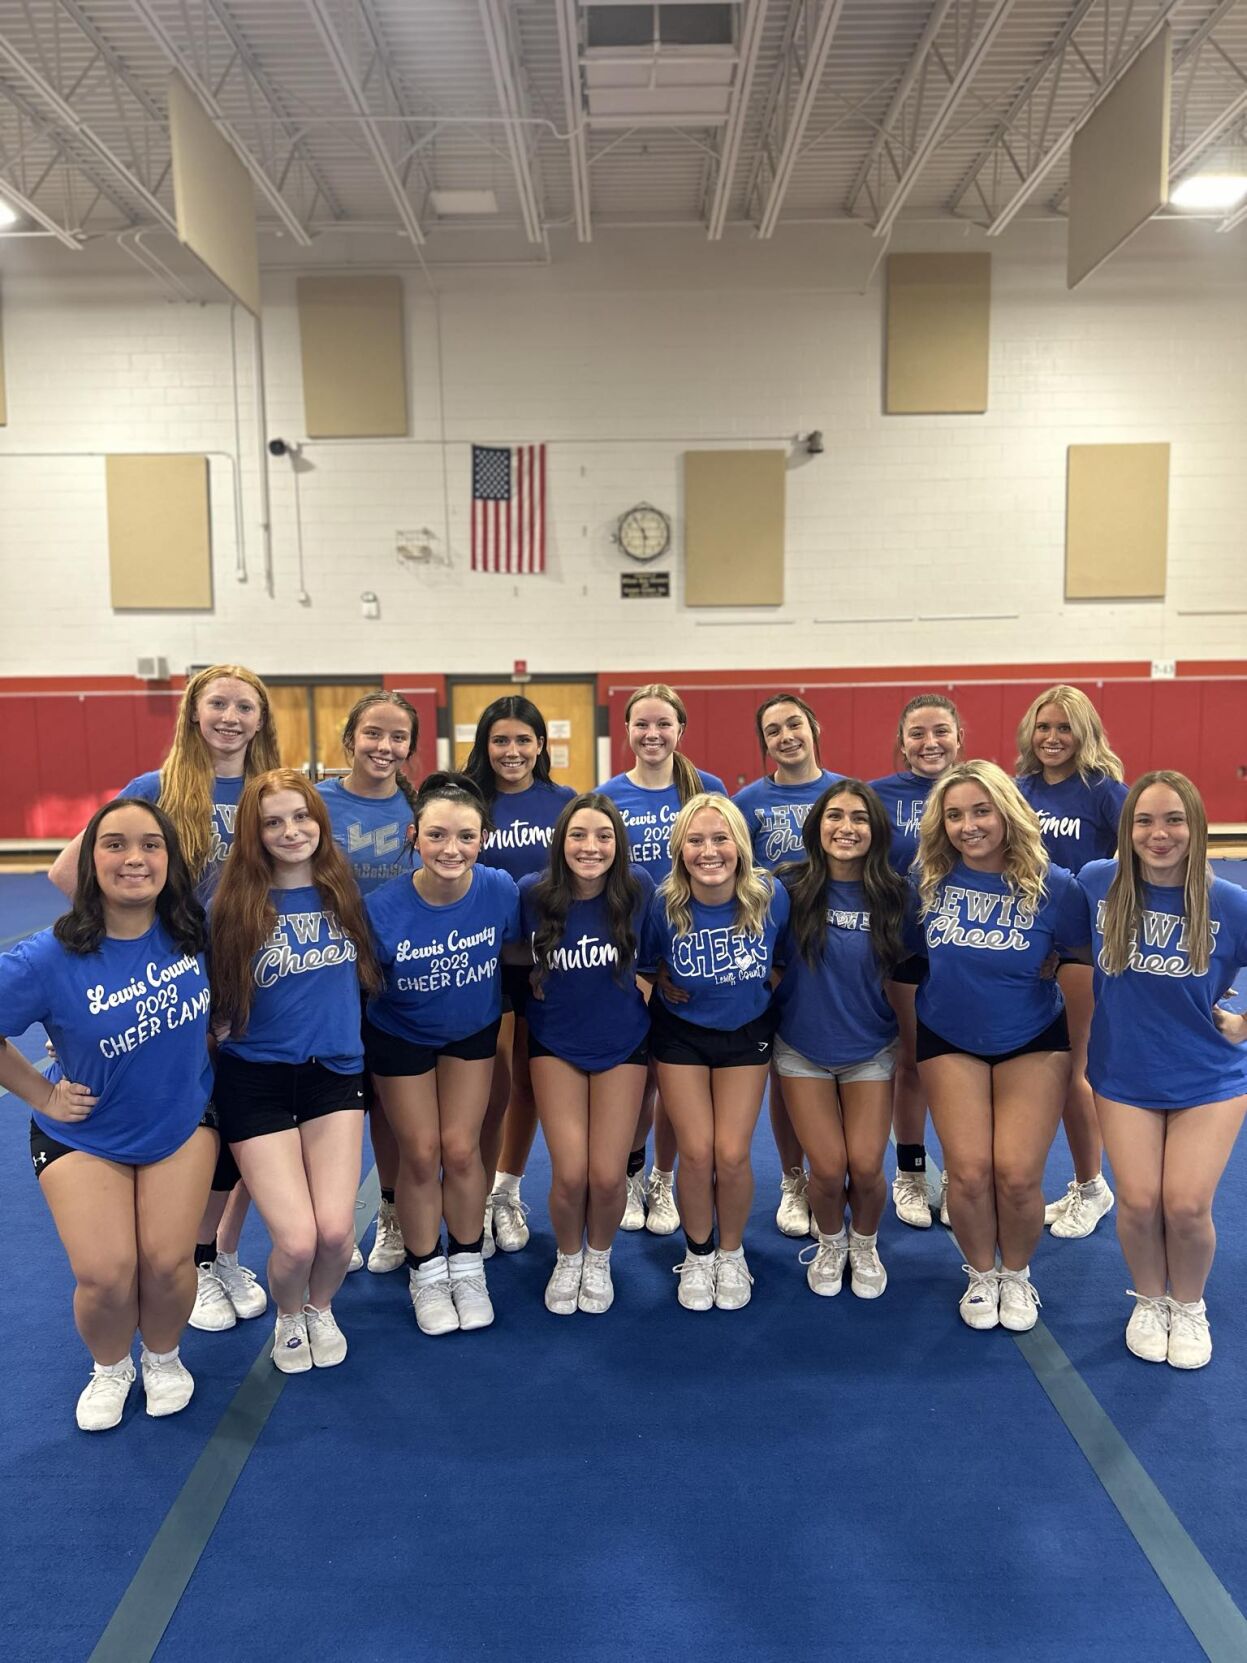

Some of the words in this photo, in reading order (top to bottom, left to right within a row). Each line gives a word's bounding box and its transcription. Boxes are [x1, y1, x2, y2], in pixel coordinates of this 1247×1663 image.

[619, 809, 657, 827] Lewis
[644, 824, 675, 842] 202
[754, 804, 815, 833] LEW
[628, 842, 662, 862] EER
[258, 910, 352, 951] EWI
[396, 939, 445, 962] Lewis
[447, 926, 496, 952] County
[927, 915, 1030, 951] Cheer
[254, 940, 358, 988] Cheer
[430, 952, 469, 973] 2023
[672, 925, 768, 978] CHEER
[86, 977, 147, 1015] Lewis
[146, 953, 200, 988] County
[397, 972, 451, 992] CHEER
[456, 957, 498, 988] CAMP
[136, 983, 178, 1022] 2023
[99, 1016, 161, 1059] CHEER
[167, 988, 211, 1030] CAMP
